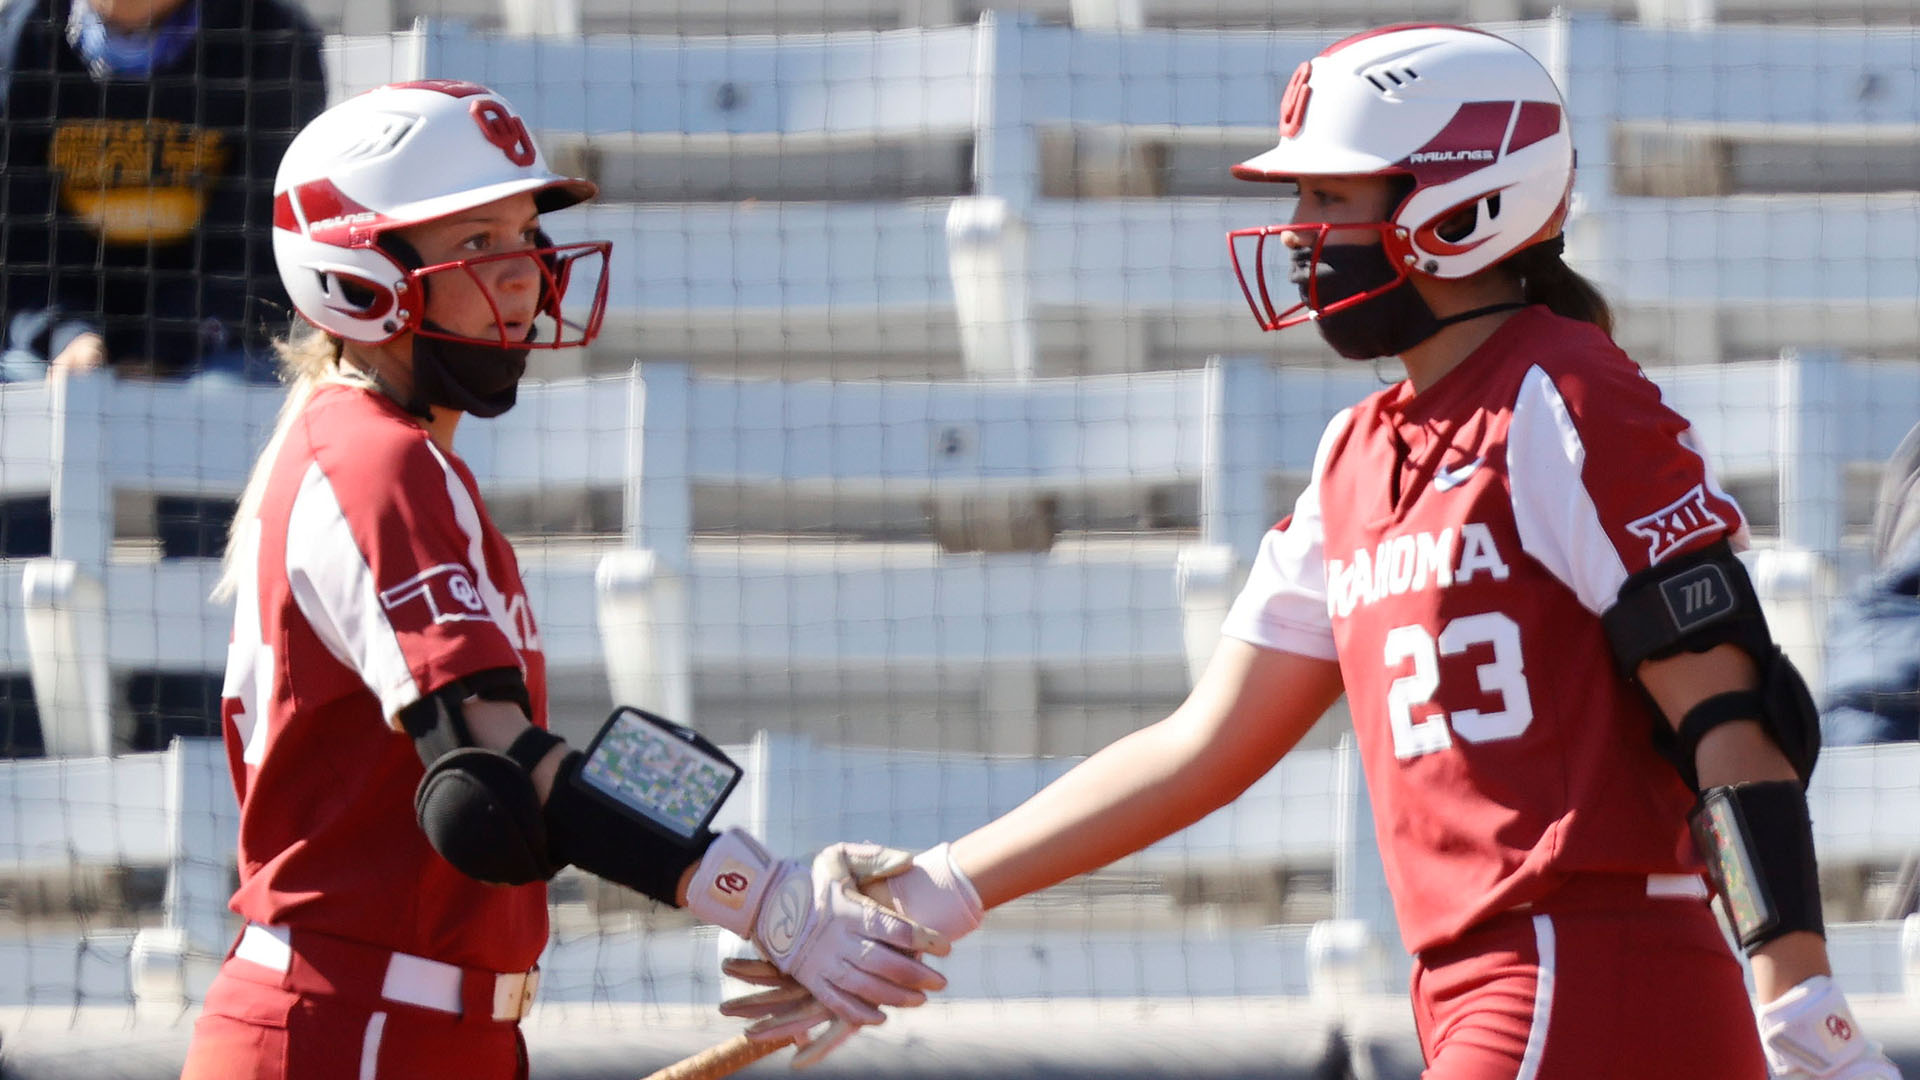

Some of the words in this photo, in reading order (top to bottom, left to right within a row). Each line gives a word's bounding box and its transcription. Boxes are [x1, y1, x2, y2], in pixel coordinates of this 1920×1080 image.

[469, 99, 536, 167] OU
[1409, 149, 1495, 164] RAWLINGS
[449, 574, 483, 611] OU
[1679, 577, 1717, 614] m
[1384, 611, 1534, 760] 23
[715, 872, 748, 894] OU
